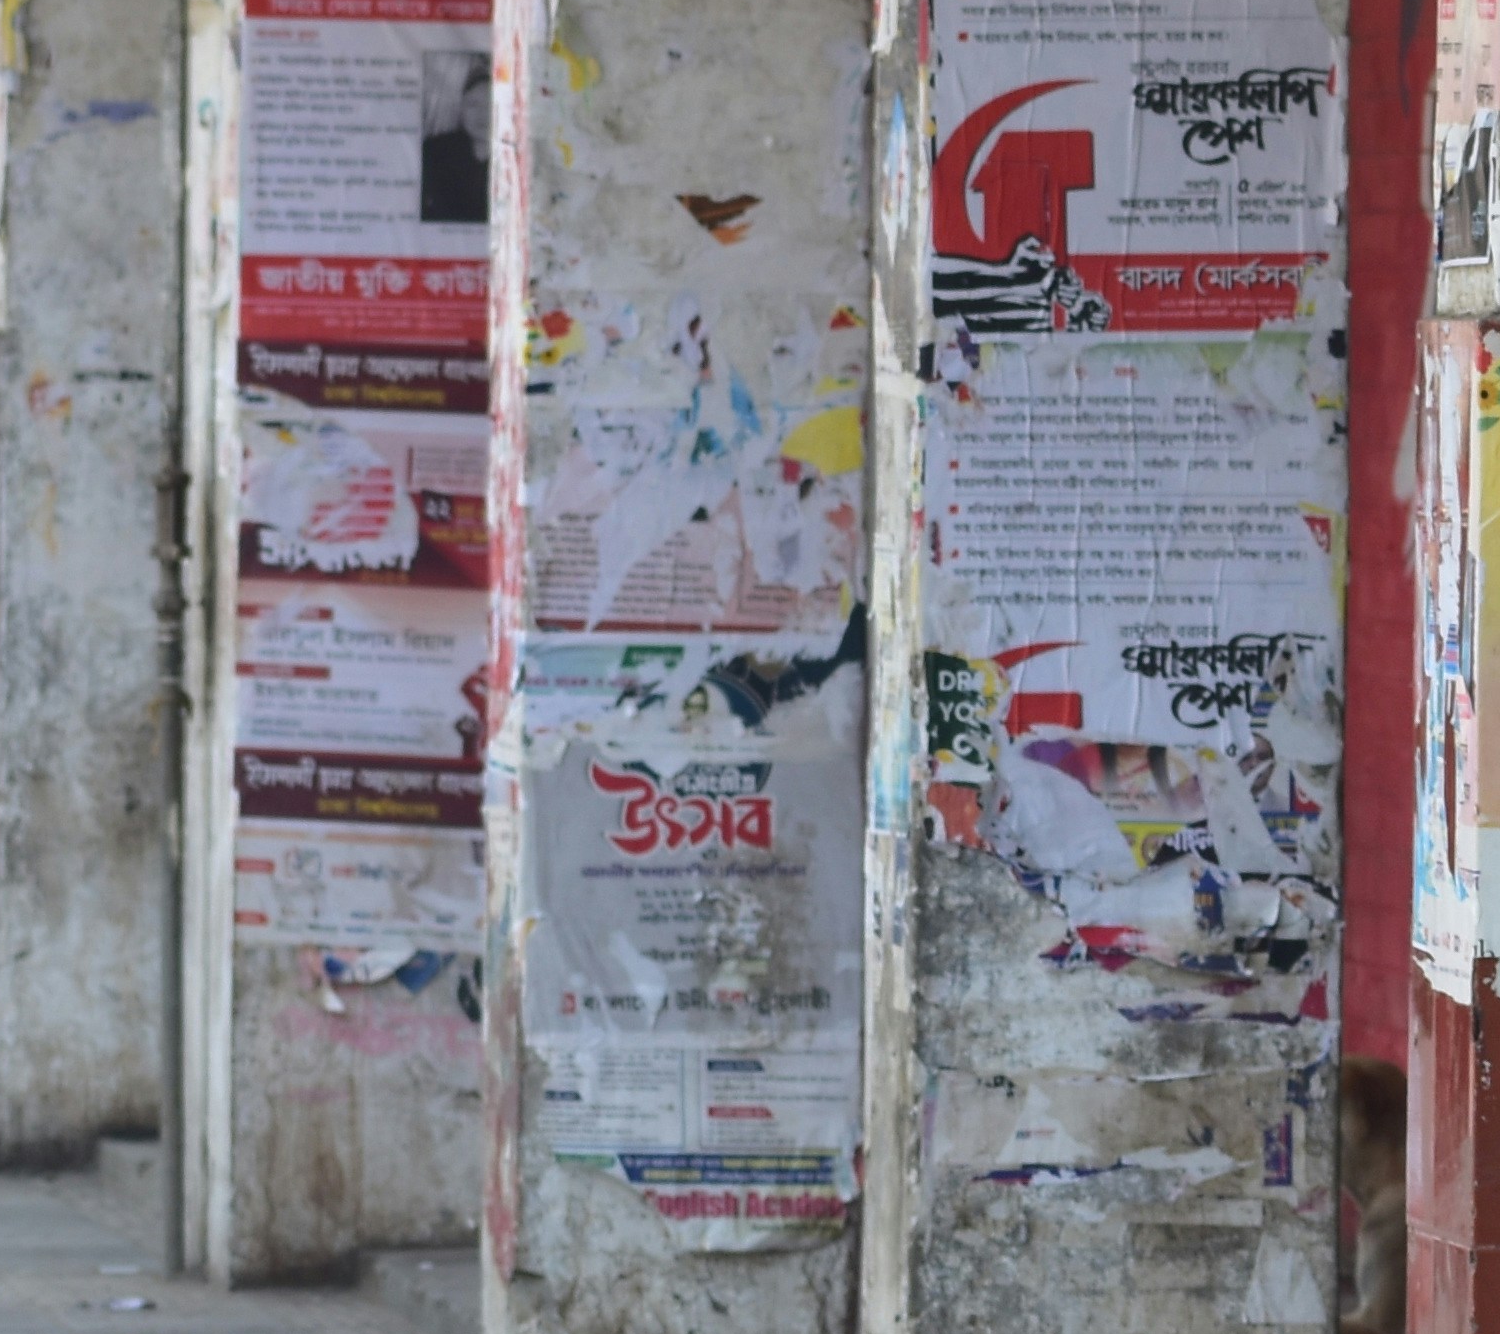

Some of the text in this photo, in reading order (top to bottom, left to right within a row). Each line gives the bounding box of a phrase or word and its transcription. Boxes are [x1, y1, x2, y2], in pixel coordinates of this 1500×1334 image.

[1133, 67, 1331, 116] স্মারকলিপি
[1178, 116, 1283, 165] পেশ
[257, 259, 346, 294] জাতীয়
[355, 259, 414, 301] মুক্তি
[1116, 264, 1185, 294] বাসদ
[590, 762, 773, 855] উৎসব
